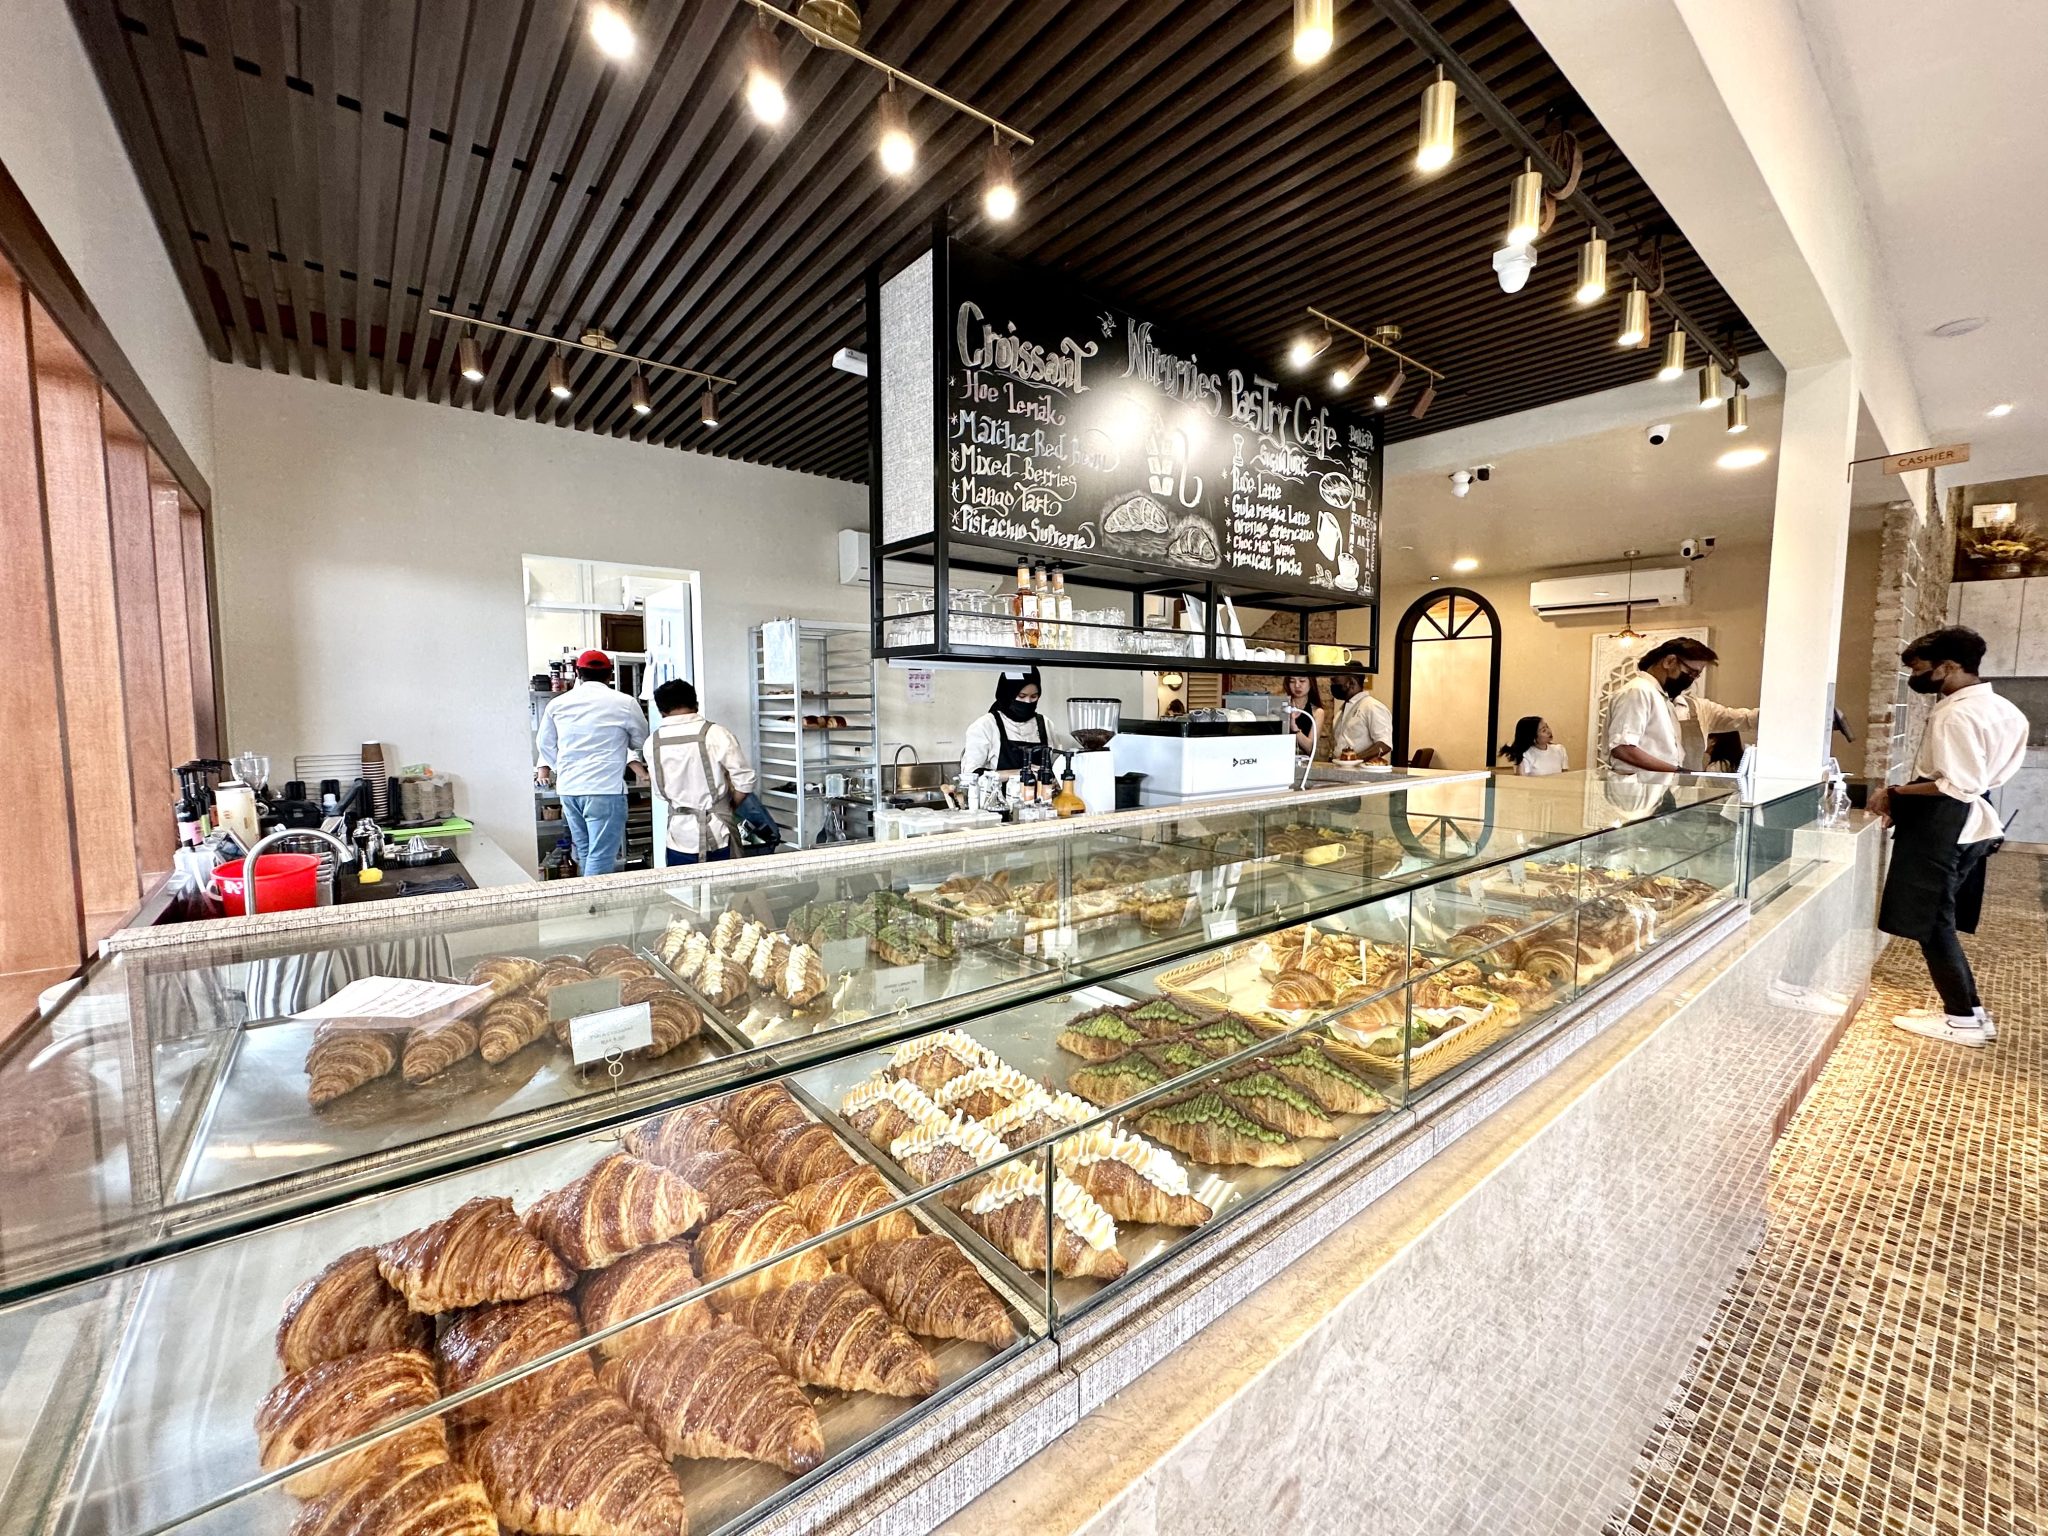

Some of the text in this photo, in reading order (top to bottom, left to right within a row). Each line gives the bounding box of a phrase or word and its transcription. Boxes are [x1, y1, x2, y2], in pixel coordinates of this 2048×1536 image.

[1294, 395, 1342, 460] Cafe
[1030, 428, 1068, 461] Red
[1897, 450, 1955, 467] CASHIER
[950, 443, 1077, 501] Mixed Berries
[1257, 472, 1282, 501] Latte
[951, 476, 1014, 517] Mango
[1288, 505, 1311, 526] Latte
